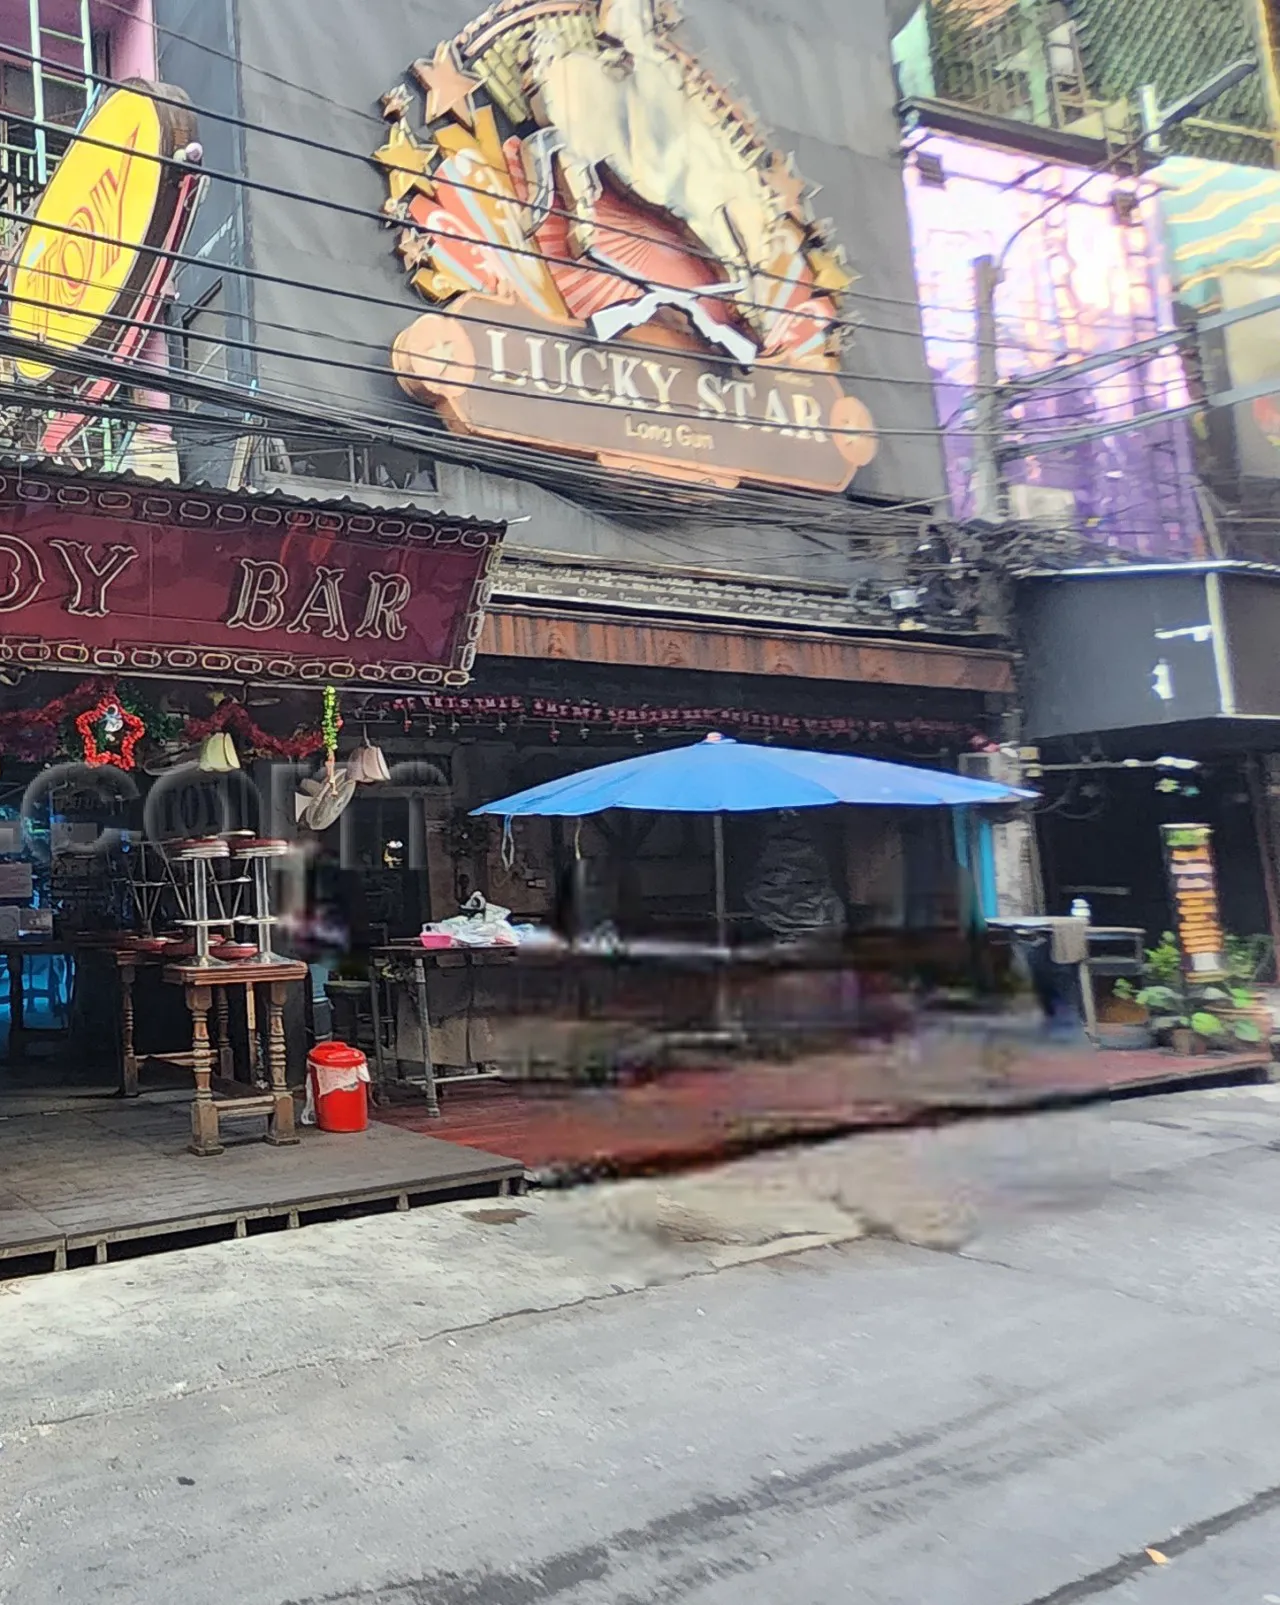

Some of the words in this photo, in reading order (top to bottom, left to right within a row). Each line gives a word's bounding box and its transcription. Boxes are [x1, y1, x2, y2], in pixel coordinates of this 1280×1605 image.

[26, 124, 140, 340] TOY
[485, 328, 681, 413] LUCKY
[696, 372, 829, 443] STAR
[624, 413, 674, 449] Long
[676, 423, 715, 450] Gun
[226, 558, 407, 641] BAR
